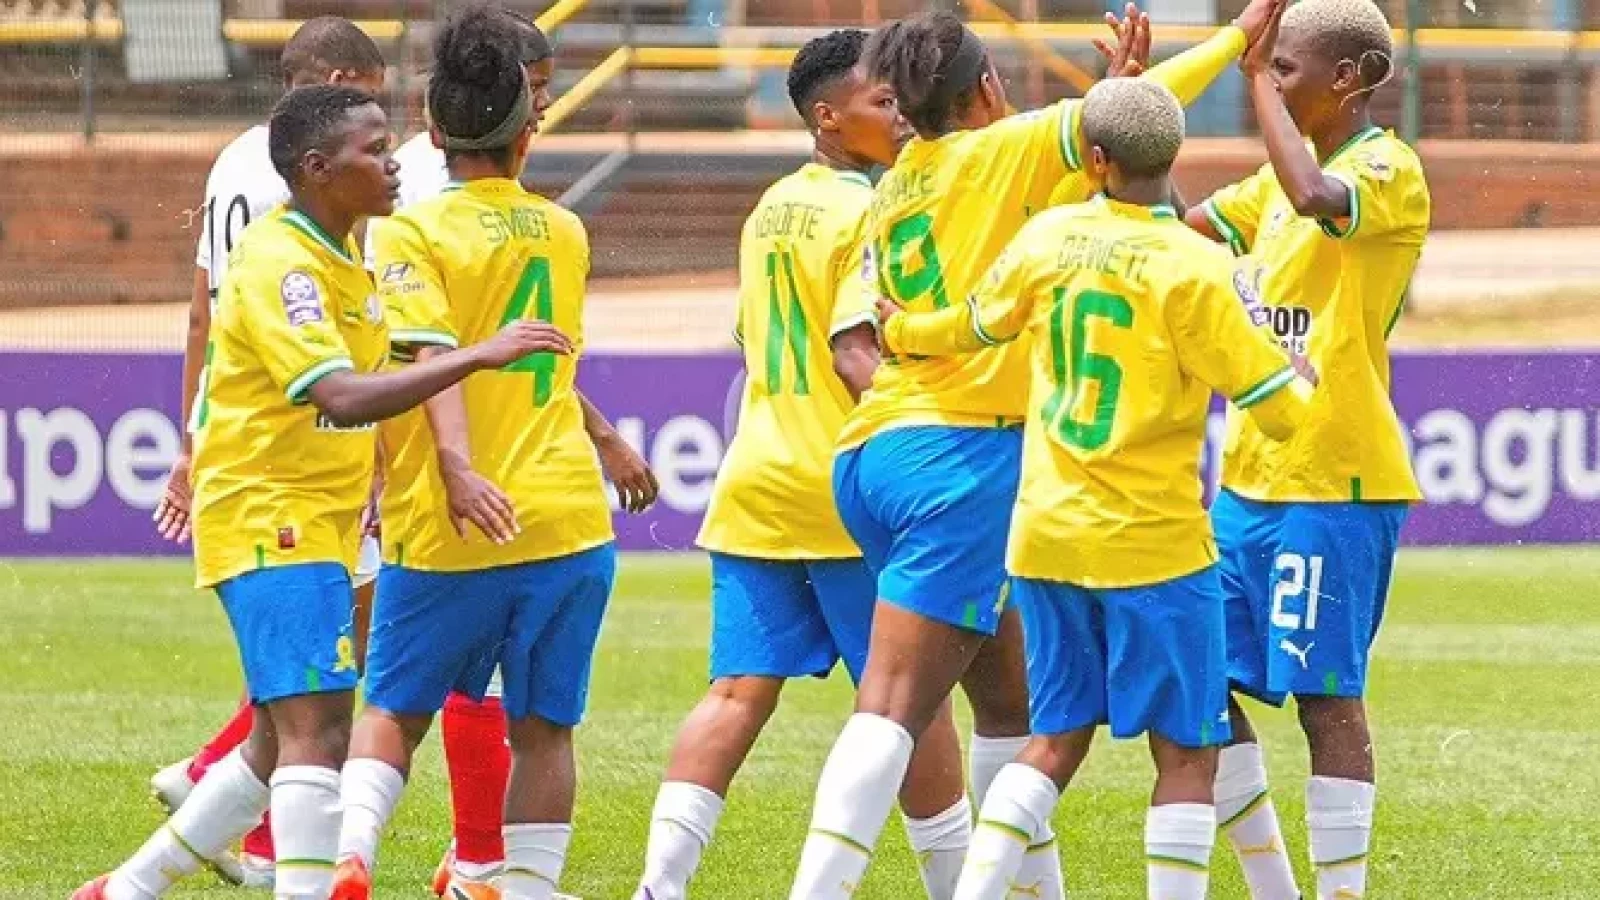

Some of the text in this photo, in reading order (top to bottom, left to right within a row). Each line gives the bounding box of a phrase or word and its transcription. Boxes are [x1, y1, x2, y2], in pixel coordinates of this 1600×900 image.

[497, 256, 556, 408] 4
[765, 251, 810, 395] 11
[1041, 287, 1135, 450] 16
[1270, 553, 1323, 630] 21
